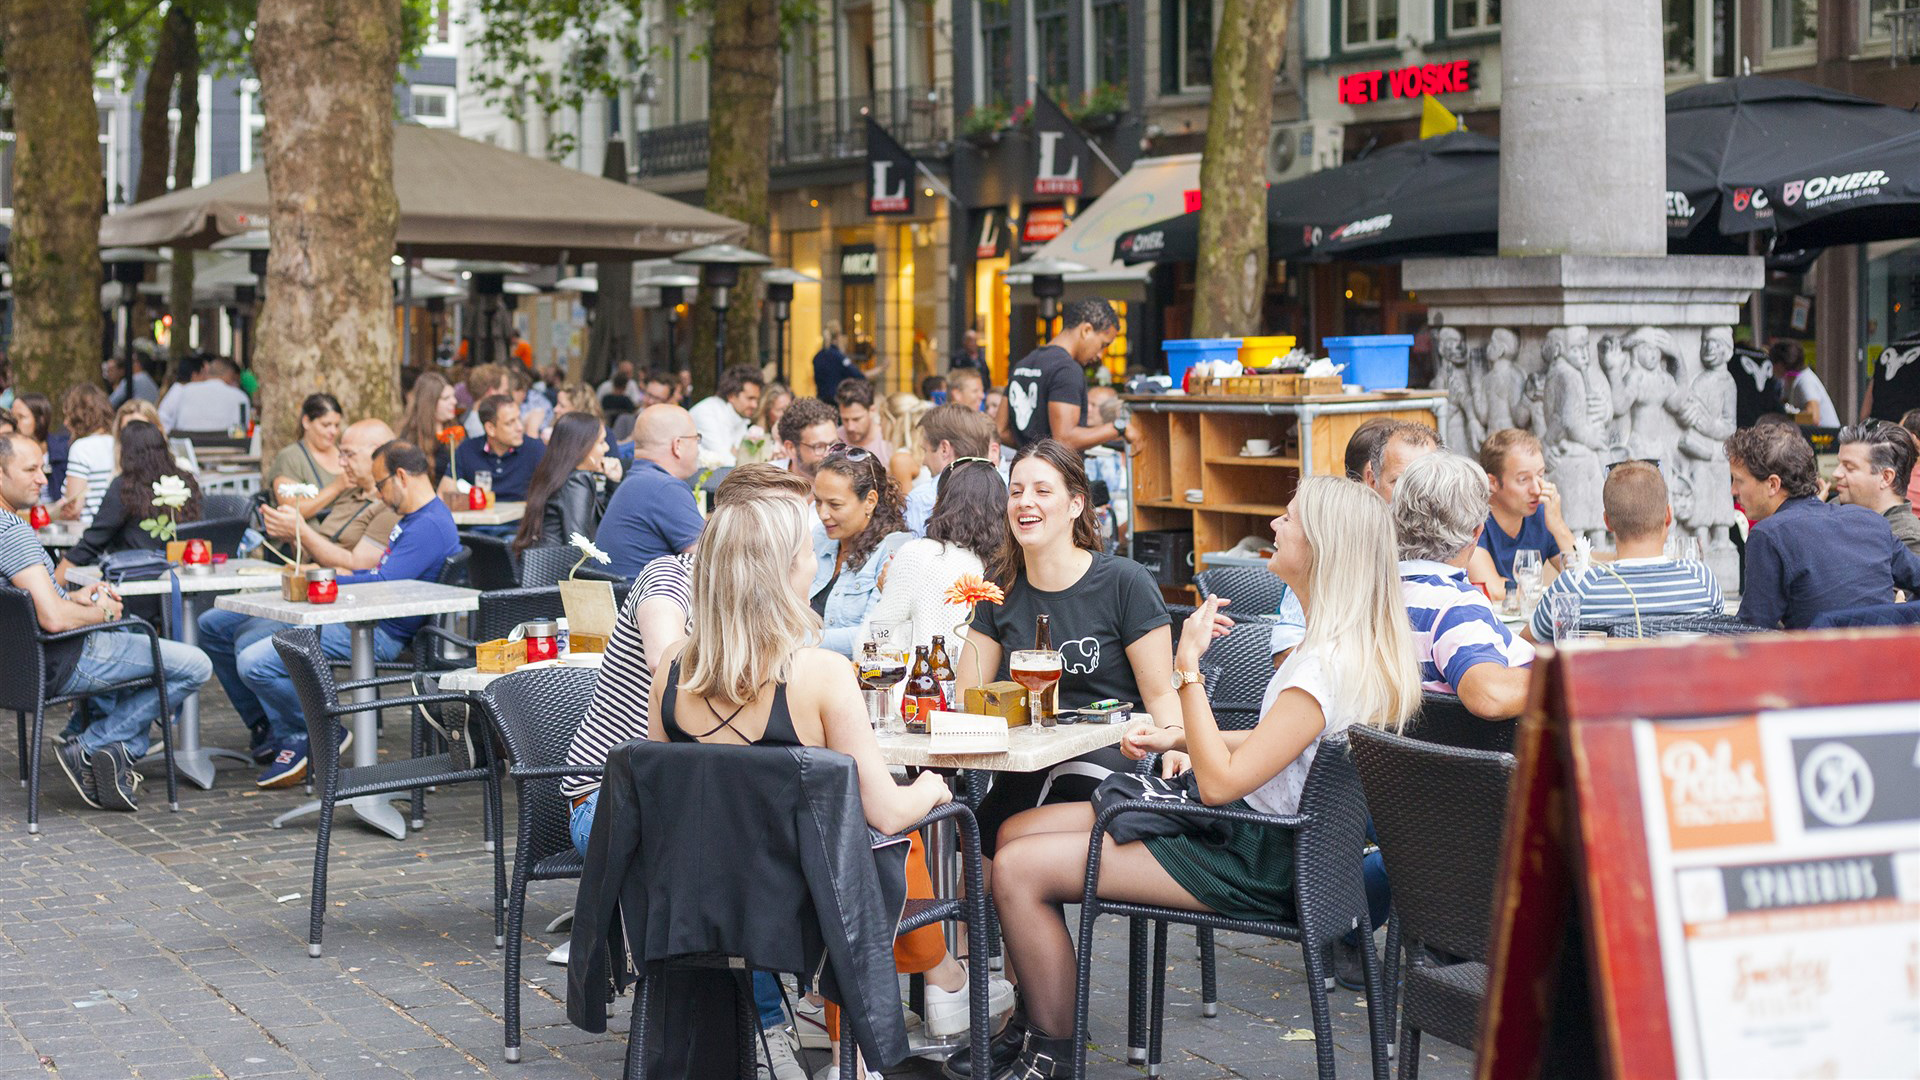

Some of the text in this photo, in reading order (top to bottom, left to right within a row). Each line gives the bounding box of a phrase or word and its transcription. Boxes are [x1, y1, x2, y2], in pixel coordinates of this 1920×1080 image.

[1338, 60, 1470, 105] HET VOSKE
[1038, 131, 1079, 180] L
[872, 160, 906, 199] L
[1804, 169, 1890, 200] OMER.
[1806, 194, 1851, 209] TRADITIONAL
